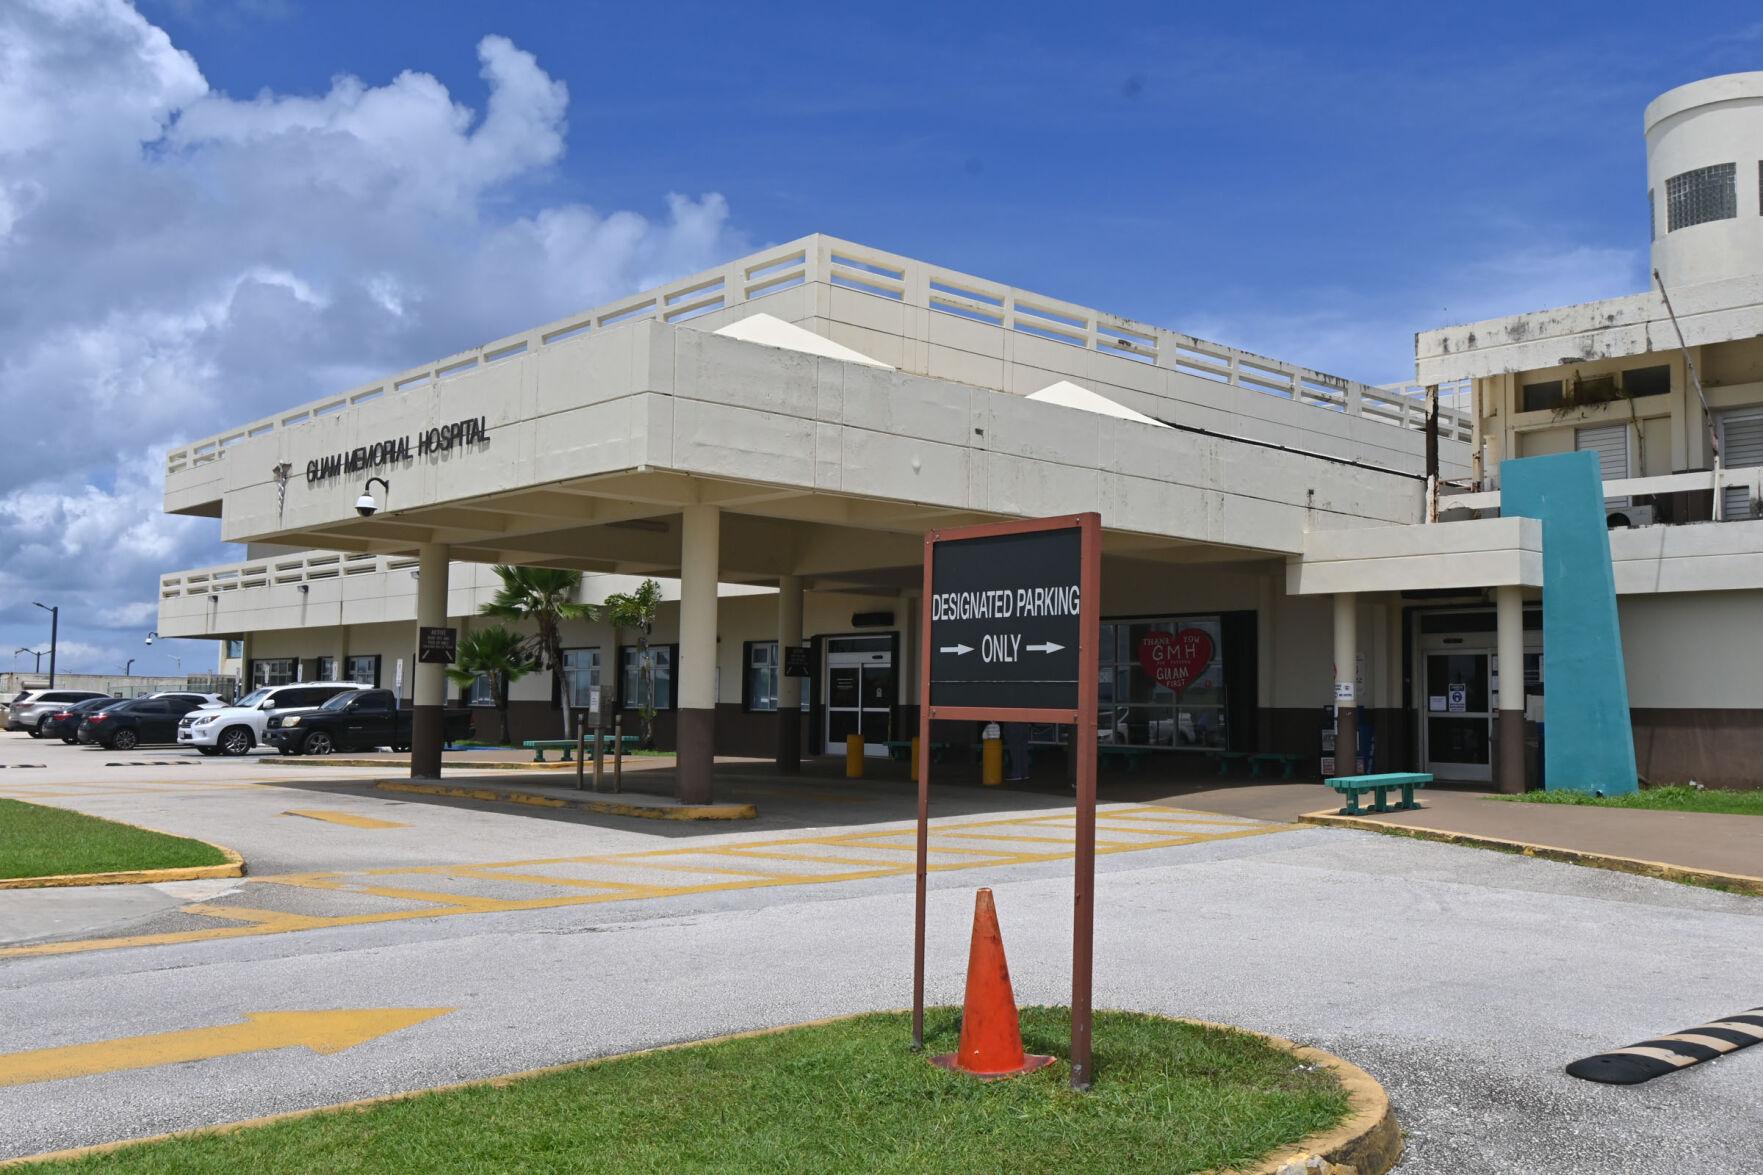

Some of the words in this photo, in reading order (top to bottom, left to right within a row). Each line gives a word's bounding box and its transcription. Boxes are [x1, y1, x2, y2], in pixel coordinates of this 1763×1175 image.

[306, 453, 342, 483] GUAM
[344, 436, 413, 474] MEMORIAL
[418, 416, 490, 456] HOSPITAL
[932, 590, 1013, 621] DESIGNATED
[1016, 585, 1080, 617] PARKING
[981, 634, 1021, 663] ONLY
[1152, 644, 1196, 661] GMH
[1156, 666, 1189, 680] GUAM
